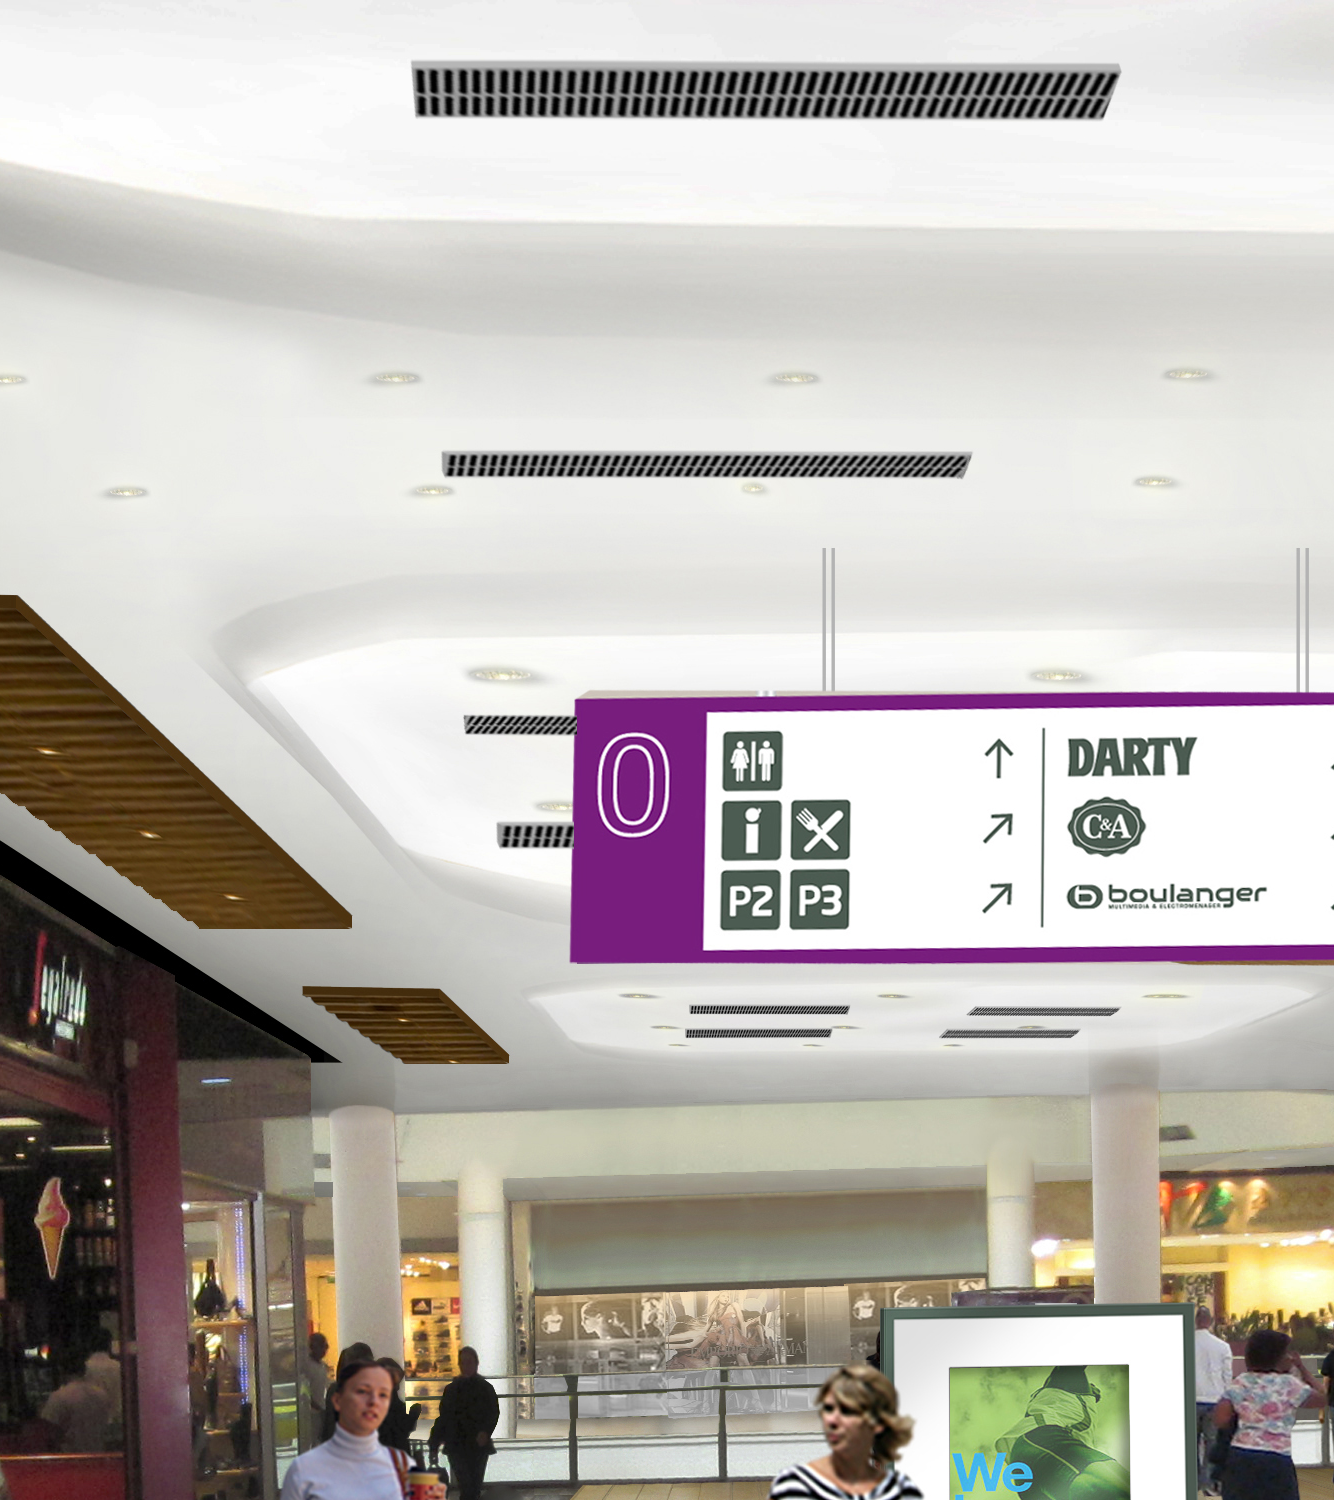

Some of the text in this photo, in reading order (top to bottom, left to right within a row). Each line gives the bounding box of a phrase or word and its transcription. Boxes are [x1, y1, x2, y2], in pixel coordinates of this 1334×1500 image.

[1068, 737, 1198, 777] DARTY
[1082, 813, 1132, 839] C&A
[729, 884, 843, 917] P2 P3
[1108, 884, 1267, 908] boulanger
[952, 1452, 1034, 1492] We
